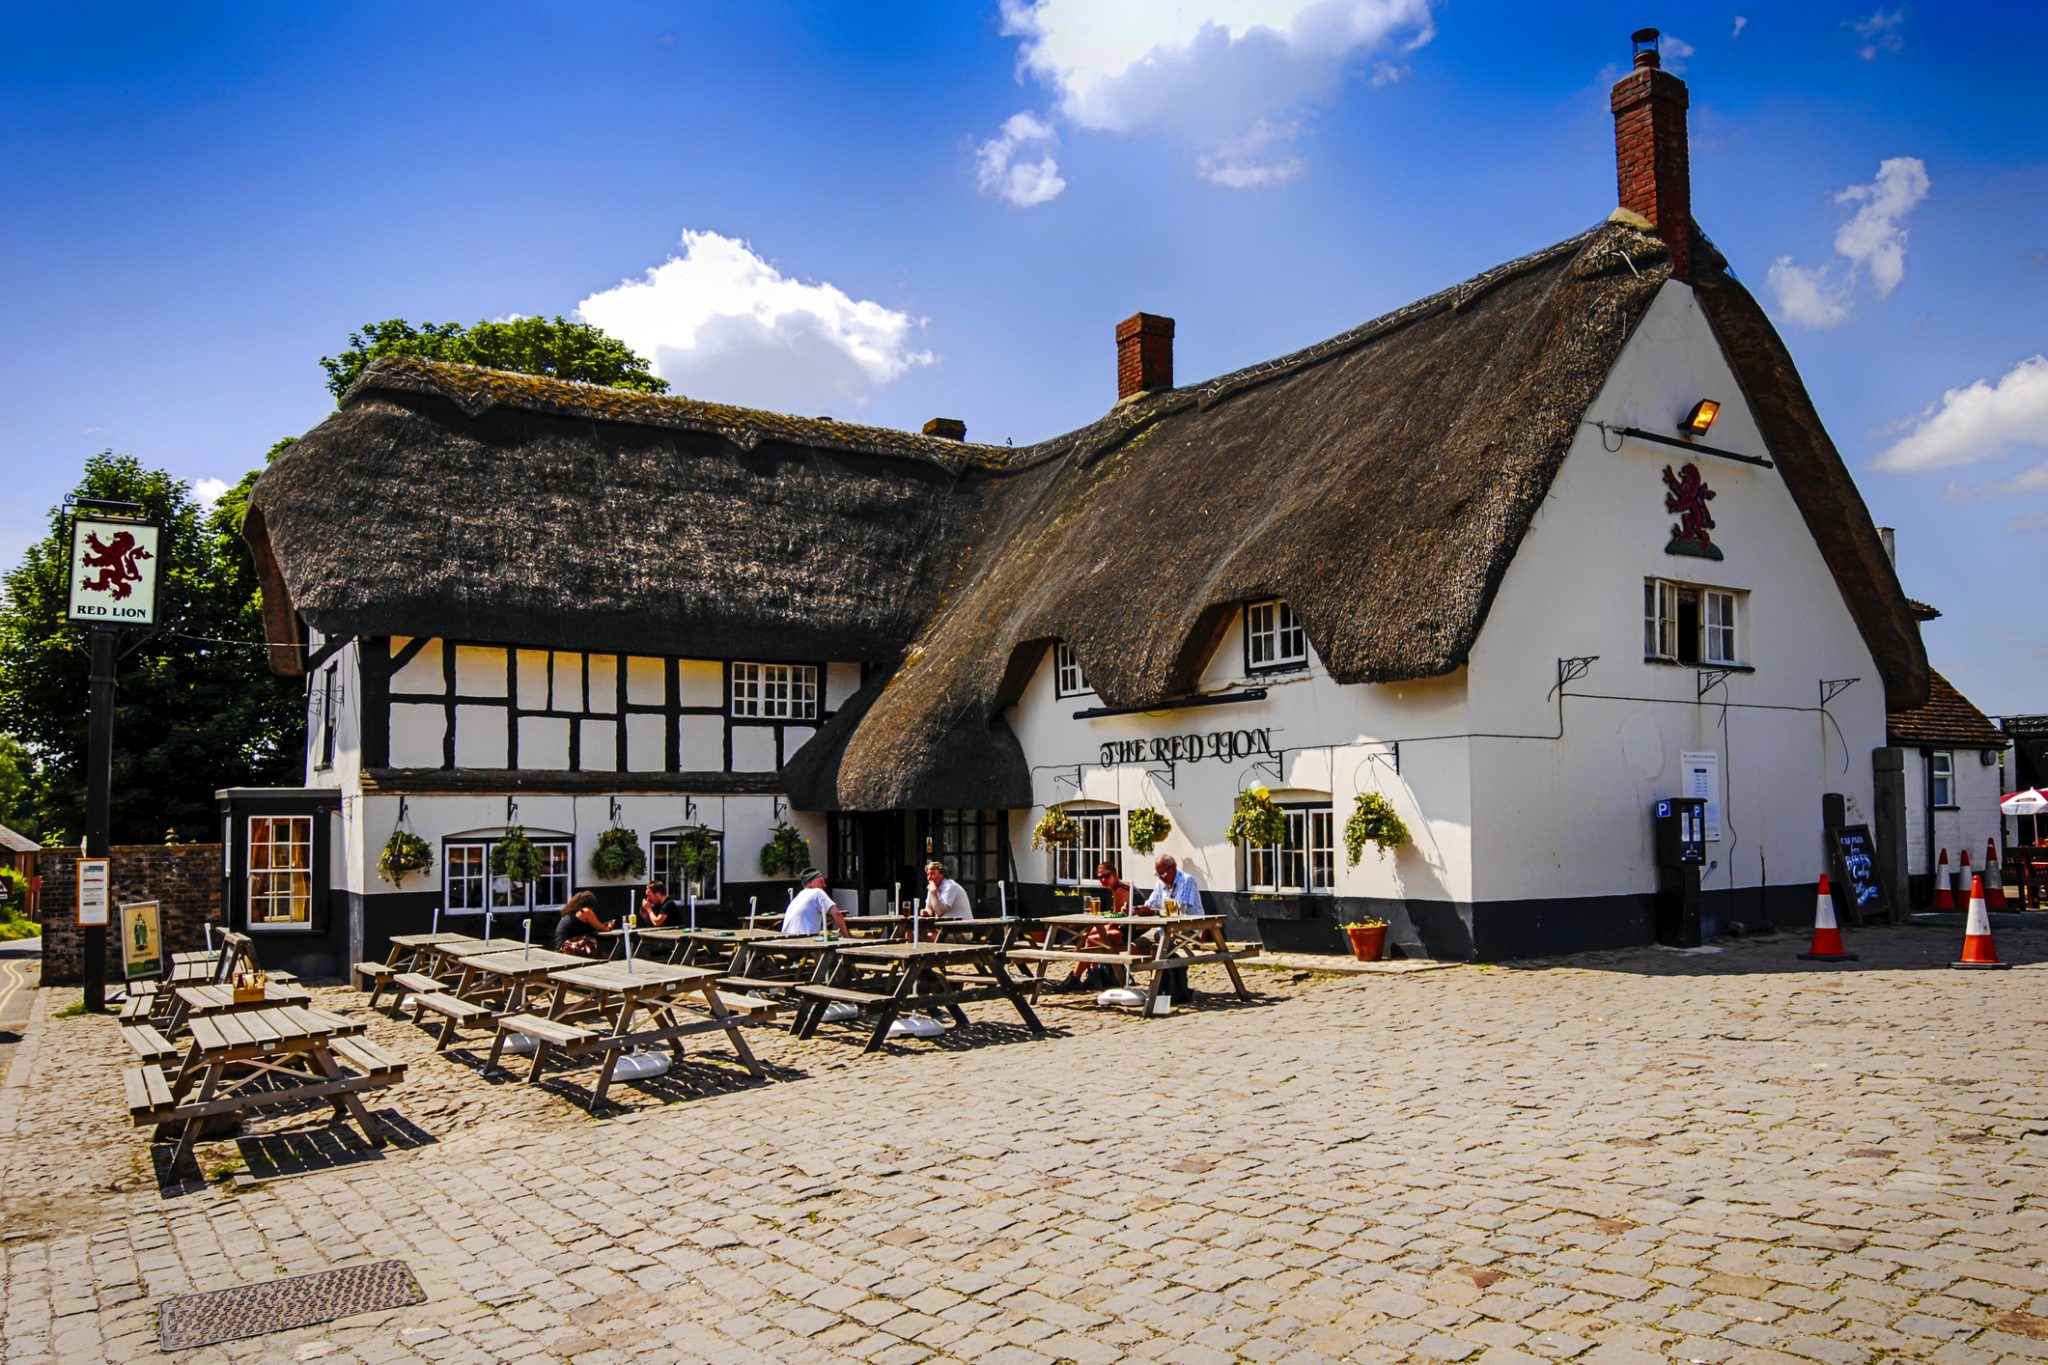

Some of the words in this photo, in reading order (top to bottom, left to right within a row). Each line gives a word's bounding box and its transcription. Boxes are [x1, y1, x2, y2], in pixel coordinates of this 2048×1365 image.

[77, 605, 107, 616] RED
[112, 607, 146, 618] LION
[1100, 739, 1146, 768] THE
[1150, 734, 1203, 768] RED
[1207, 728, 1280, 764] LION
[1658, 803, 1667, 816] P
[1695, 806, 1701, 816] P
